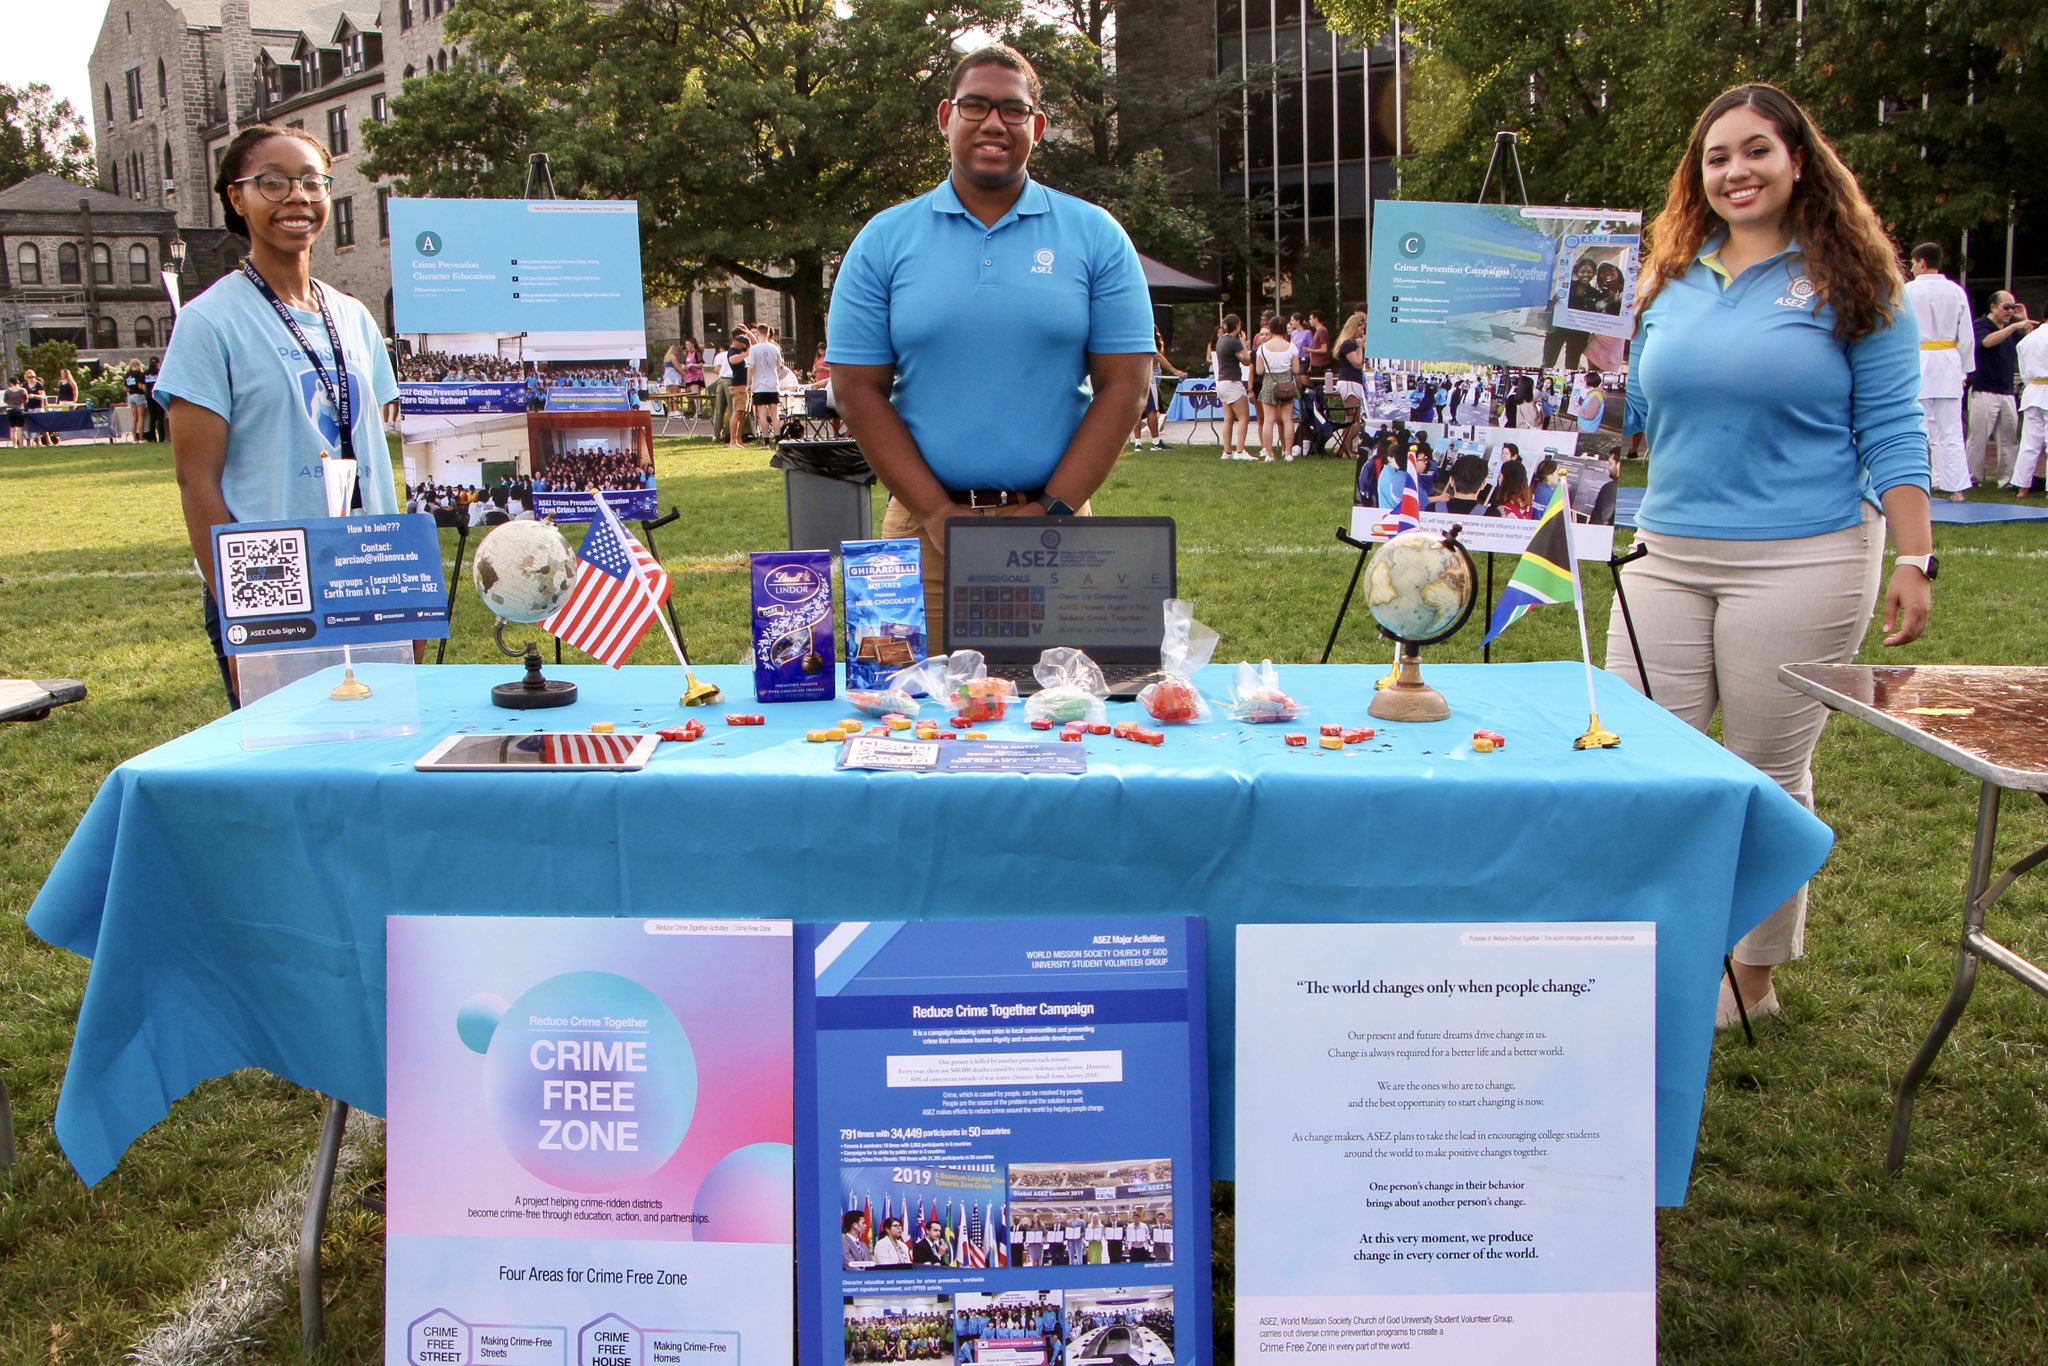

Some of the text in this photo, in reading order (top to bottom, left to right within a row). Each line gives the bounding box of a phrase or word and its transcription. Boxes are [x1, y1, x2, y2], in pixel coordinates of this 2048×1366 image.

[423, 236, 435, 251] A
[1405, 237, 1419, 253] C
[1583, 235, 1608, 244] ASEZ
[412, 260, 479, 269] Crime Prevention
[1031, 266, 1053, 274] ASEZ
[1394, 263, 1510, 277] Crime Prevention Campaigns
[413, 271, 495, 280] Character Educations
[1509, 264, 1548, 284] Together
[1774, 297, 1808, 308] ASEZ
[272, 300, 290, 320] PENN
[319, 367, 332, 390] PENN
[341, 401, 349, 424] PENN
[346, 522, 400, 533] How to Join???
[360, 542, 392, 552] Contact:
[1006, 550, 1059, 568] ASEZ
[850, 565, 916, 575] GHIRARDELLI
[328, 573, 431, 589] vugroups [search] Save the
[774, 572, 803, 582] Lindt
[1001, 574, 1031, 583] GOALS
[1050, 573, 1160, 584] S A V E
[324, 587, 343, 598] Earth
[345, 586, 363, 597] from
[365, 586, 370, 595] A
[372, 586, 379, 595] to
[381, 585, 386, 594] Z
[421, 583, 437, 592] ASEZ
[775, 586, 808, 594] LINDOR
[867, 582, 901, 590] SQUARES
[874, 597, 916, 605] CHOCOLATE
[763, 608, 778, 616] DARK
[281, 627, 296, 635] Sign
[689, 924, 708, 932] Together
[1092, 934, 1165, 945] ASEZ Major Activities
[1025, 948, 1167, 959] WORLD MISSION SOCIETY CHURCH OF GOD
[1296, 978, 1595, 998] “The world changes only when people change.”
[912, 1001, 1094, 1019] Reduce Crime Together Campaign
[528, 1015, 648, 1029] Reduce Crime Together
[529, 1039, 647, 1072] CRIME
[543, 1080, 635, 1112] FREE
[538, 1119, 639, 1152] ZONE
[839, 1128, 856, 1139] 791
[856, 1130, 874, 1138] times
[875, 1129, 890, 1137] with
[890, 1127, 922, 1140] 34,449
[922, 1128, 960, 1138] participants
[968, 1126, 980, 1137] 50
[981, 1127, 1010, 1135] countries
[893, 1167, 931, 1185] 2019
[1369, 1180, 1525, 1193] One person’s change in their behavior
[514, 1195, 662, 1209] A project helping crime-ridden districts
[1366, 1196, 1525, 1210] brings about another person’s change.
[1359, 1233, 1372, 1243] At
[1375, 1232, 1394, 1243] this
[1396, 1236, 1418, 1246] very
[1421, 1234, 1469, 1243] moment,
[1488, 1230, 1533, 1245] produce
[1353, 1249, 1390, 1264] change
[1393, 1249, 1403, 1260] in
[1406, 1252, 1433, 1263] every
[1472, 1247, 1485, 1259] of
[1486, 1247, 1502, 1259] the
[1505, 1247, 1538, 1258] world.
[499, 1265, 687, 1285] Four Areas for Crime Free Zone
[423, 1326, 457, 1337] CRIME
[594, 1331, 629, 1342] CRIME
[427, 1339, 454, 1349] FREE
[480, 1335, 552, 1347] Making Crime-Free
[653, 1340, 726, 1353] Making Crime-Free
[480, 1347, 507, 1358] Streets
[598, 1344, 625, 1355] FREE
[419, 1351, 461, 1362] STREET
[592, 1356, 631, 1366] HOUSE
[653, 1353, 680, 1363] Homes
